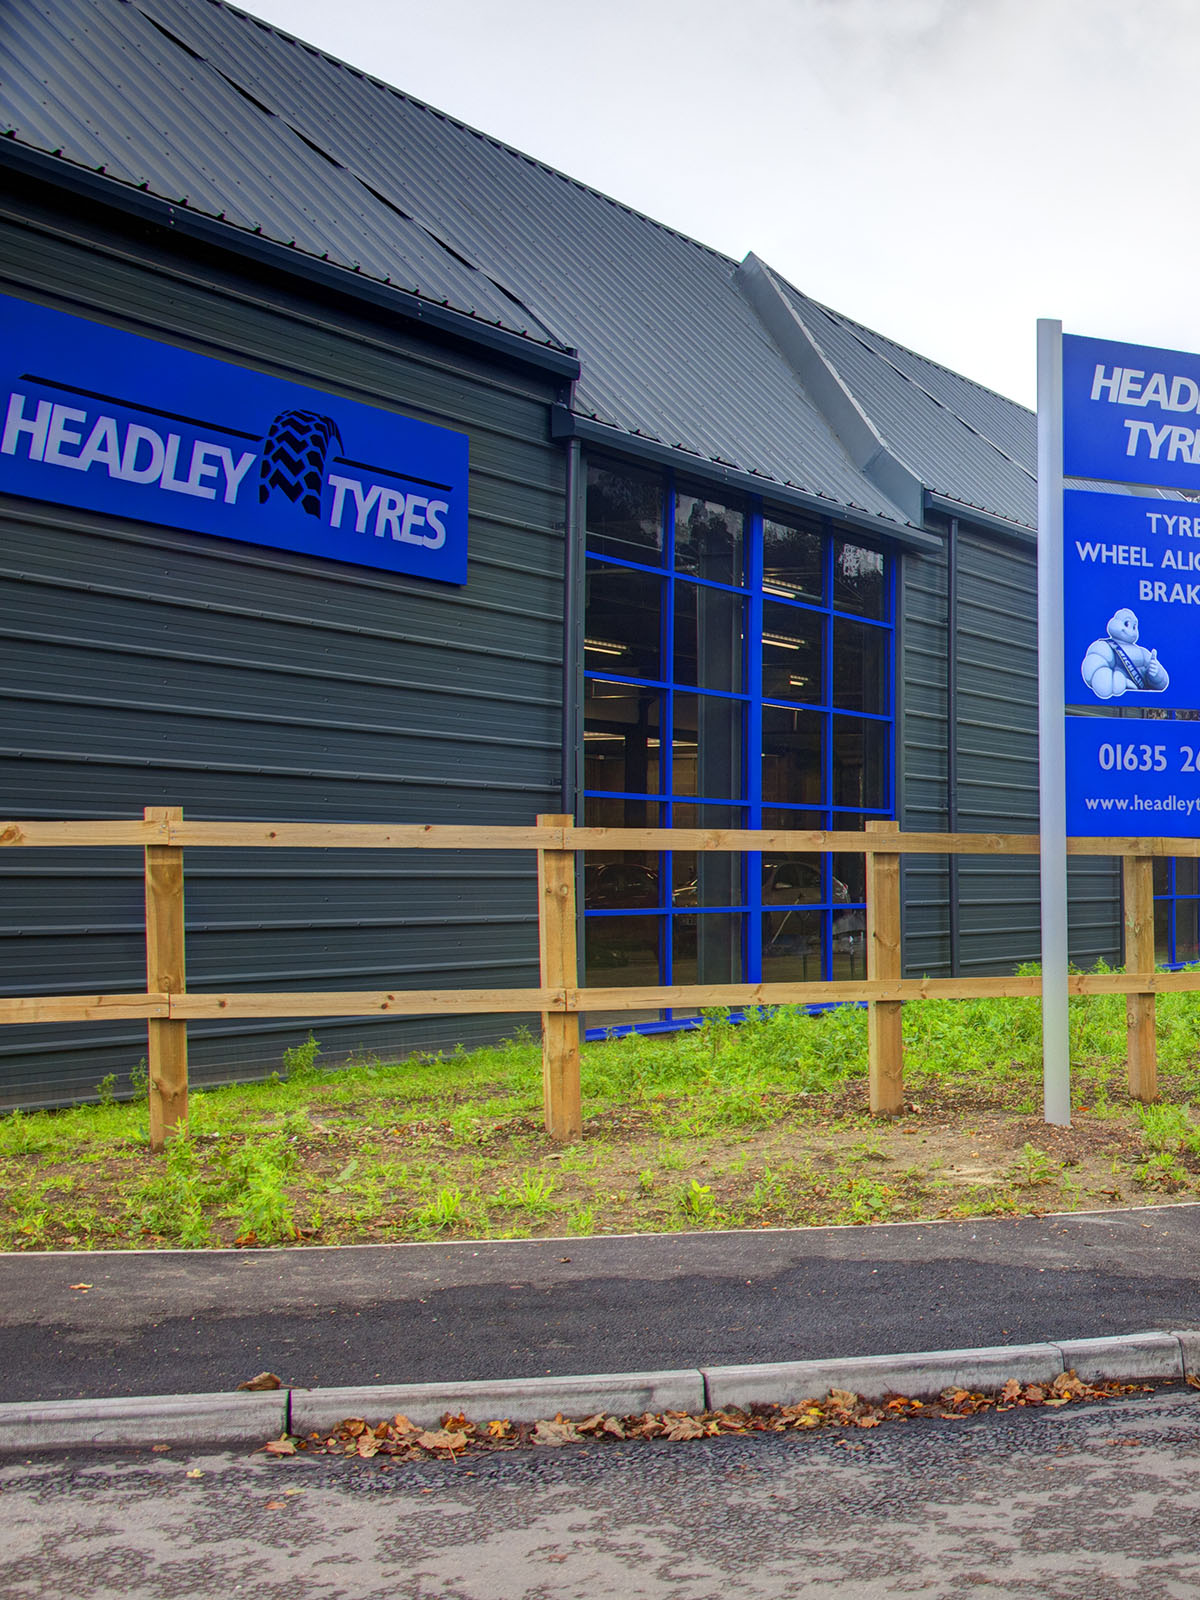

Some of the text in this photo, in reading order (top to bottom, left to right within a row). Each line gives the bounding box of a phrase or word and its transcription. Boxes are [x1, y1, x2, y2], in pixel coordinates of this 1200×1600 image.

[1, 393, 449, 549] HEADLEY TYRES
[1075, 541, 1154, 568] WHEEL
[1098, 743, 1167, 772] 01635
